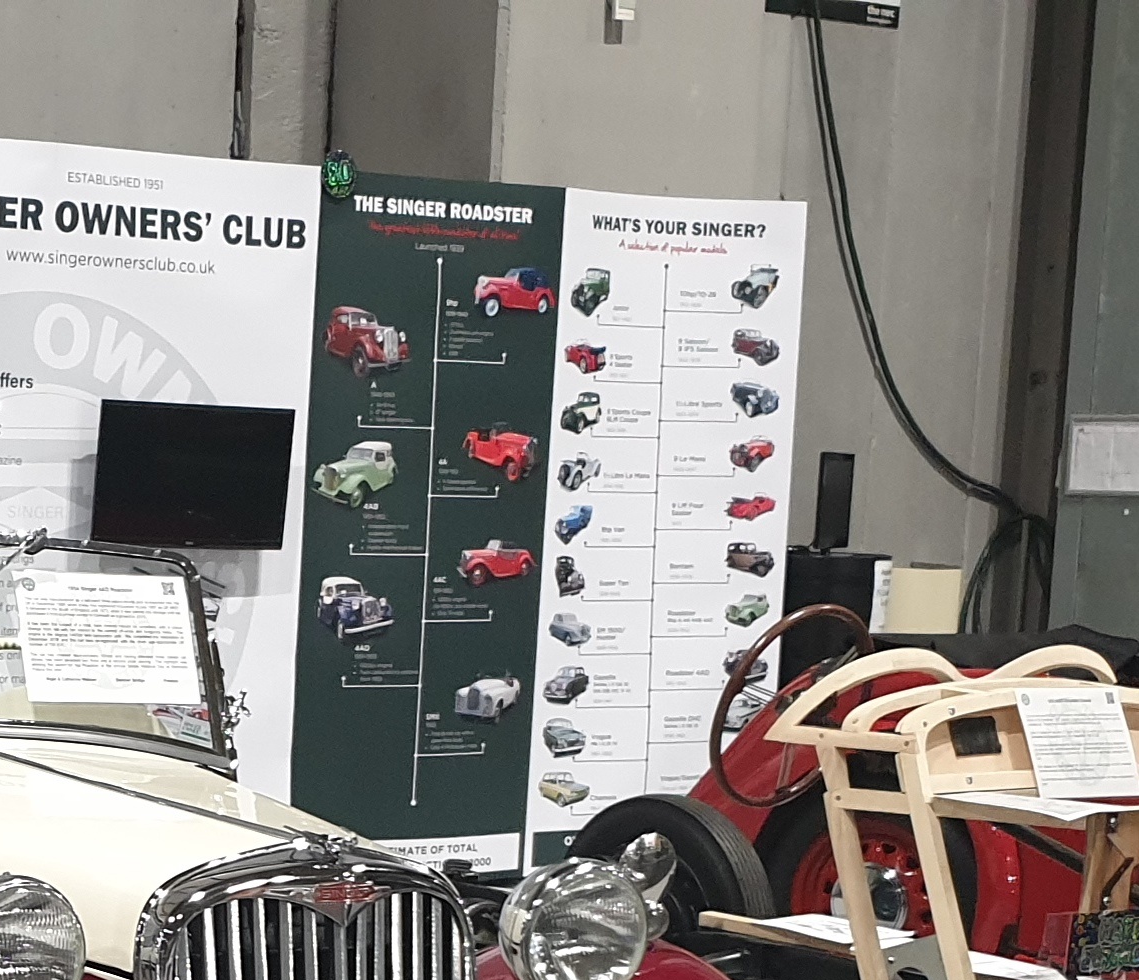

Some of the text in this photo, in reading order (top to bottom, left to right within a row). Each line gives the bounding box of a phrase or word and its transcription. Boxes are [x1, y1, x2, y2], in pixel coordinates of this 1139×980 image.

[67, 171, 164, 191] ESTABLISHED 1951
[353, 195, 533, 224] THE SINGER ROADSTER
[55, 201, 213, 242] OWNERS'
[222, 214, 307, 249] CLUB
[592, 215, 767, 238] WHAT'S YOUR SINGER?
[6, 248, 216, 276] www.singerownersclub.co.uk
[8, 506, 64, 518] SINGER
[431, 845, 445, 855] OF
[447, 843, 478, 854] TOTAL
